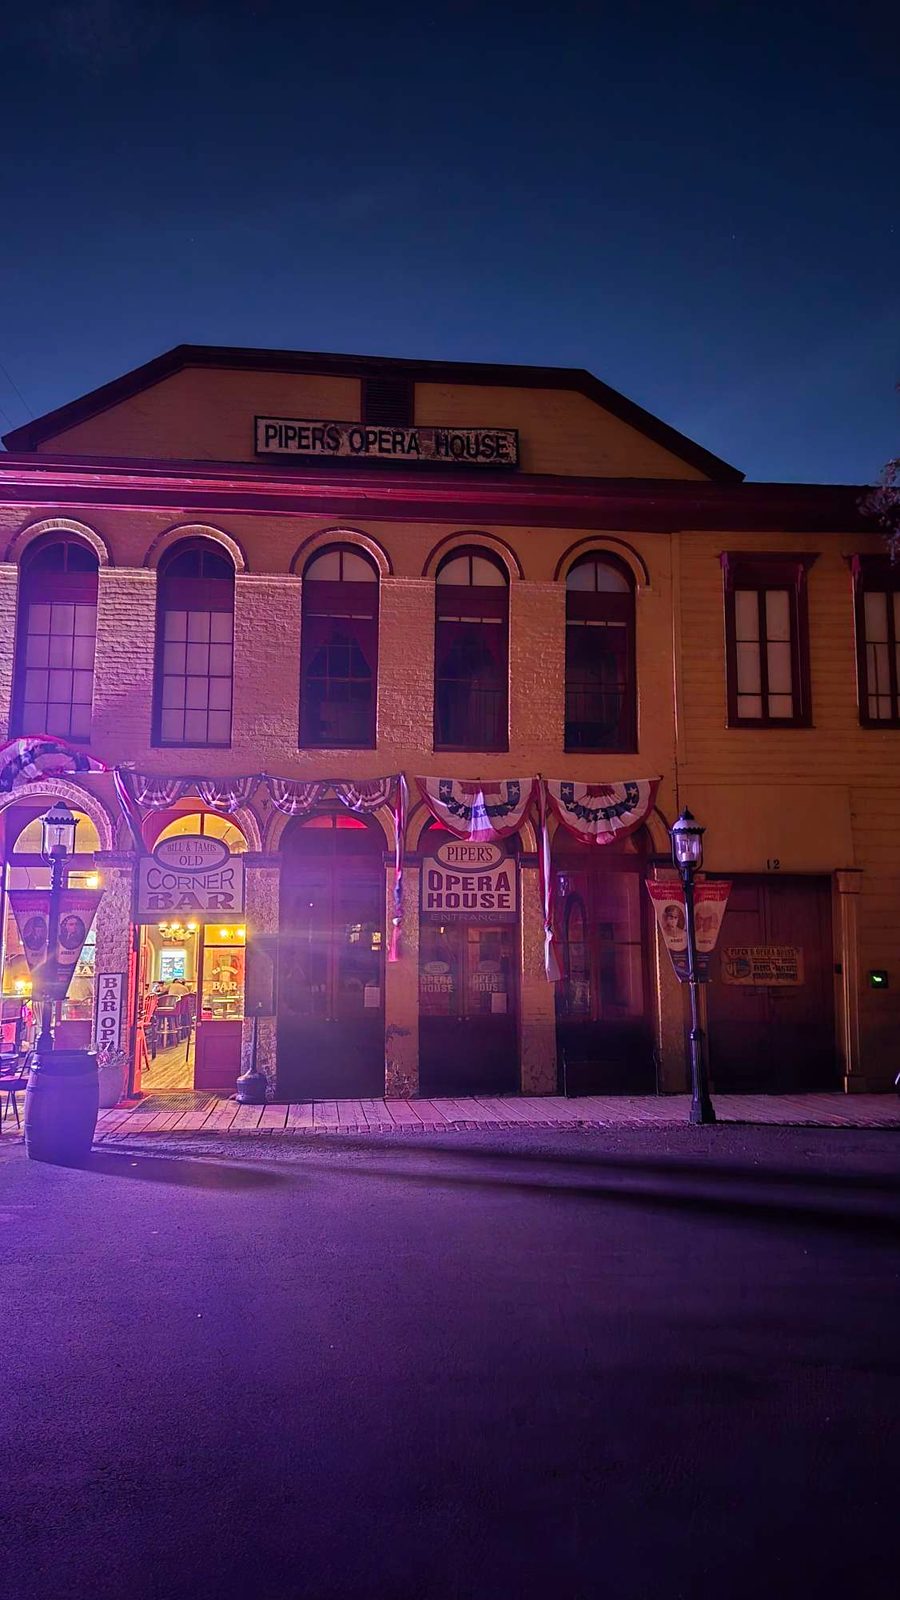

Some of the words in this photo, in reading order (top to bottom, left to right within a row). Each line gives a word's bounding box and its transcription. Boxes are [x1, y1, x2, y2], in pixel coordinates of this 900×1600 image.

[348, 427, 421, 455] OPERA
[434, 432, 510, 459] HOUSE
[167, 842, 183, 852] BILL
[186, 841, 192, 852] &
[179, 855, 204, 866] OLD
[766, 859, 781, 870] 12
[146, 868, 235, 890] CORNER
[428, 869, 511, 891] OPERA
[146, 891, 235, 910] BAR
[427, 893, 511, 909] HOUSE
[430, 913, 507, 922] ENTRANCE
[100, 977, 118, 1013] BAR
[212, 981, 238, 993] BAR
